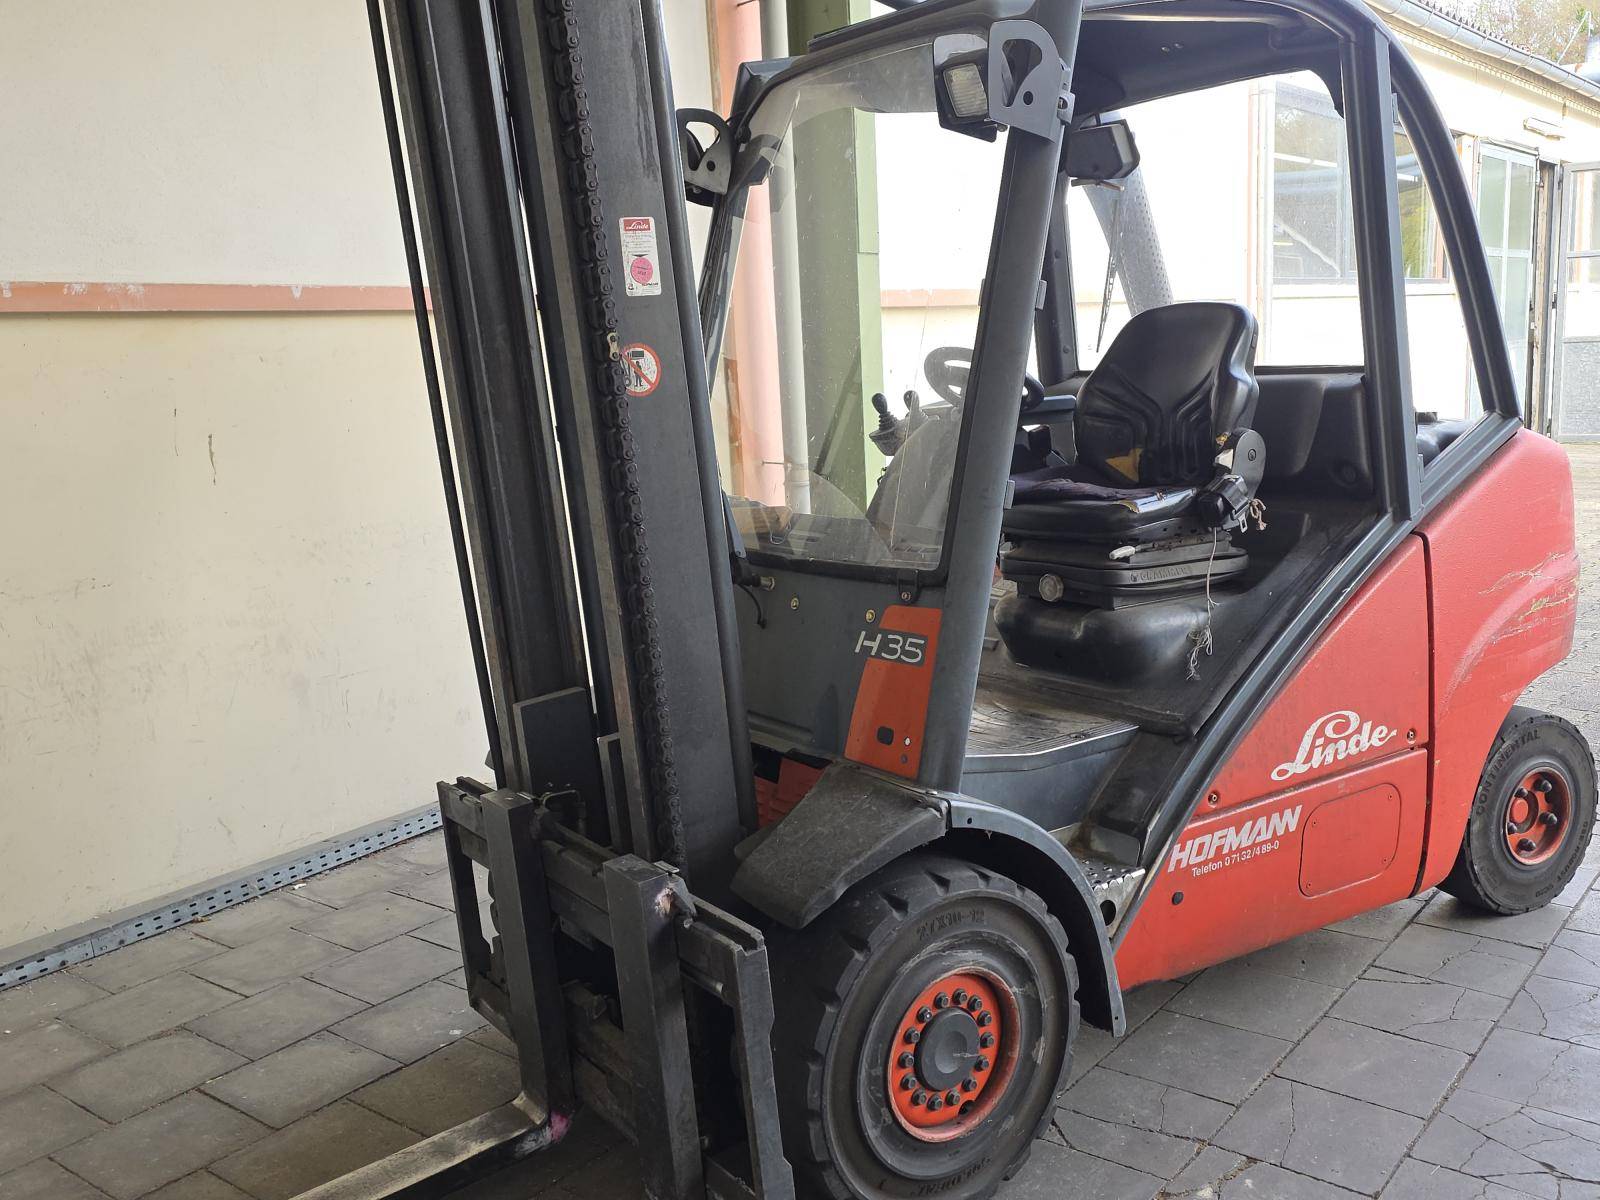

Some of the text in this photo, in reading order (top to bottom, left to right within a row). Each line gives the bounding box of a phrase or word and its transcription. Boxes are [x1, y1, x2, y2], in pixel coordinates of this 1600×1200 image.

[625, 220, 649, 230] Linde
[855, 629, 925, 664] H35
[1270, 710, 1398, 781] Linde
[1476, 729, 1541, 816] CONTINENTAL
[1168, 805, 1302, 873] HOFMANN
[1192, 860, 1222, 877] Telefon
